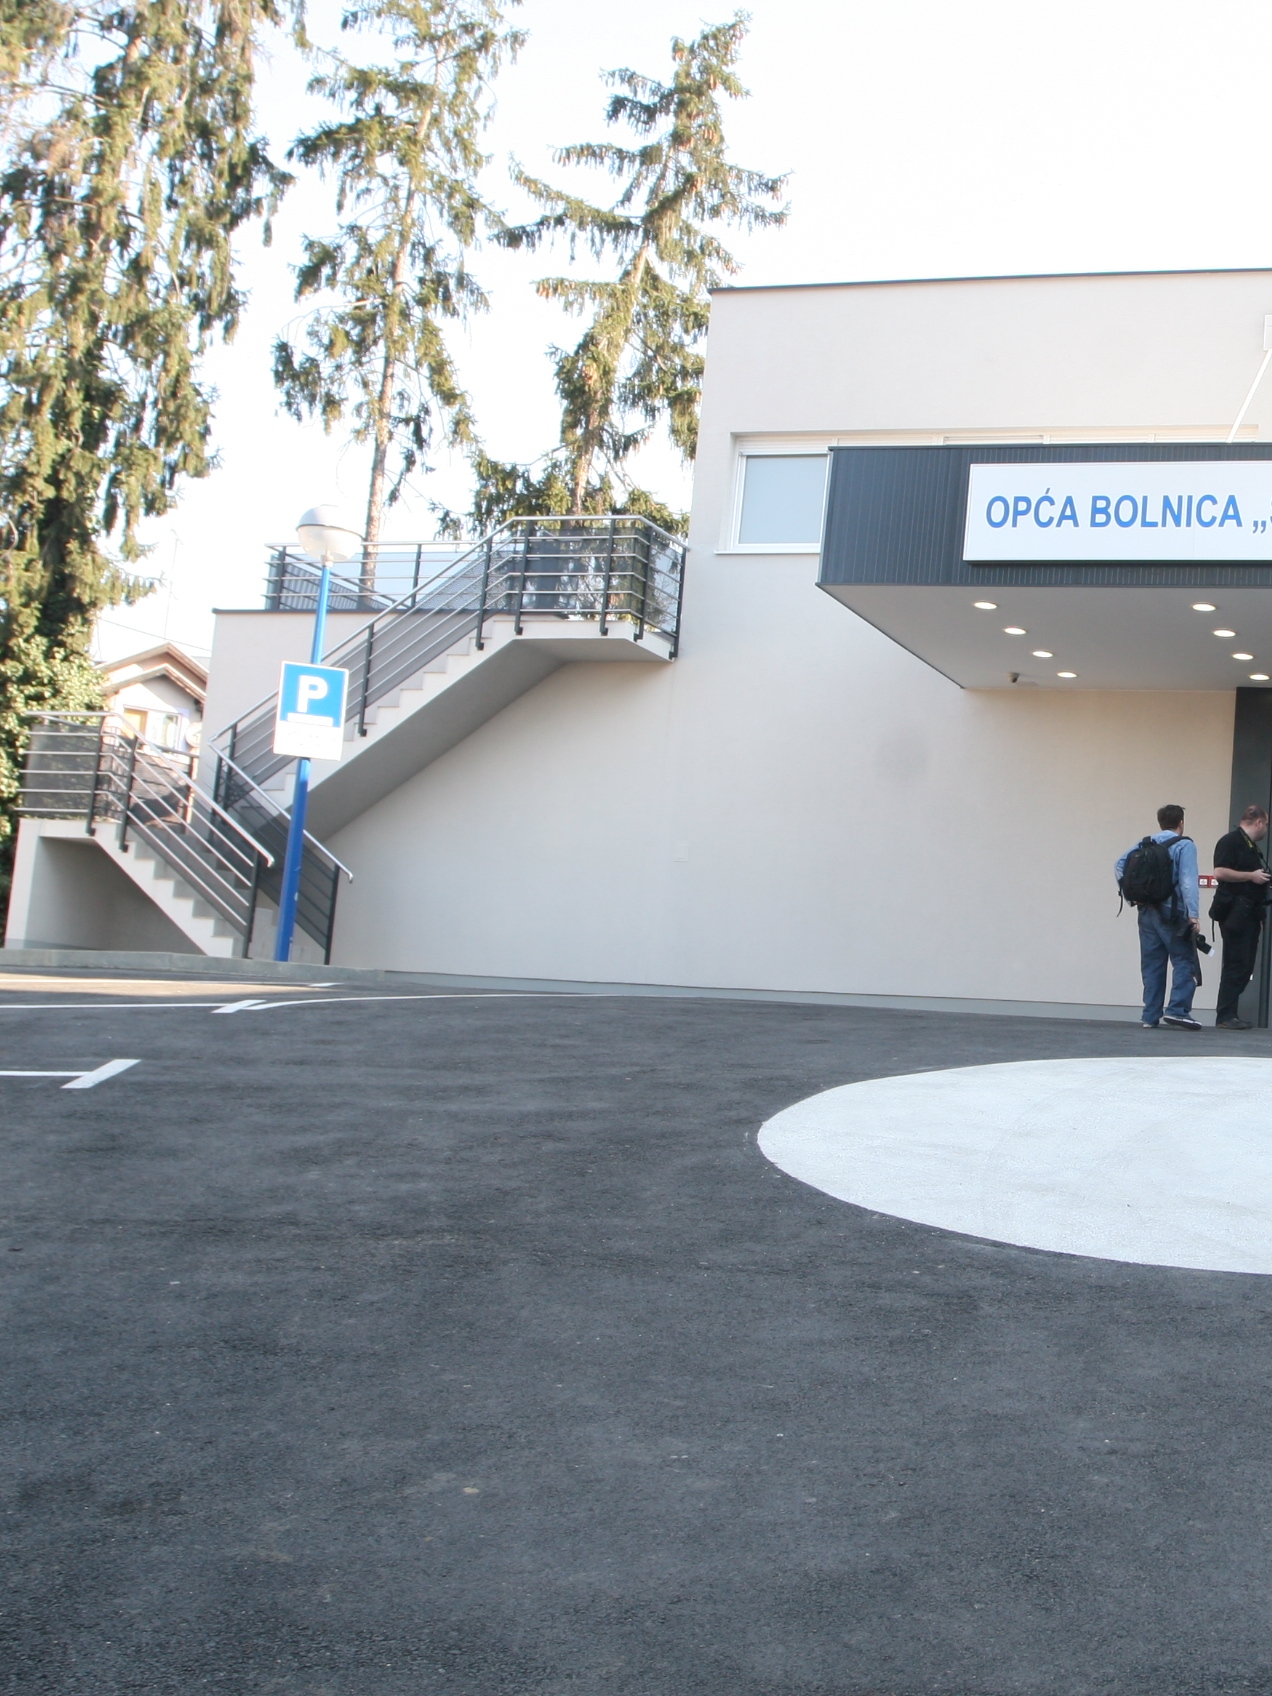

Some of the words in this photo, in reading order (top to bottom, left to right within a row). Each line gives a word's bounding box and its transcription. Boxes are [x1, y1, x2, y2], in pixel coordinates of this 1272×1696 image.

[986, 487, 1080, 529] OPĆA
[1088, 494, 1243, 529] BOLNICA
[297, 674, 328, 713] P
